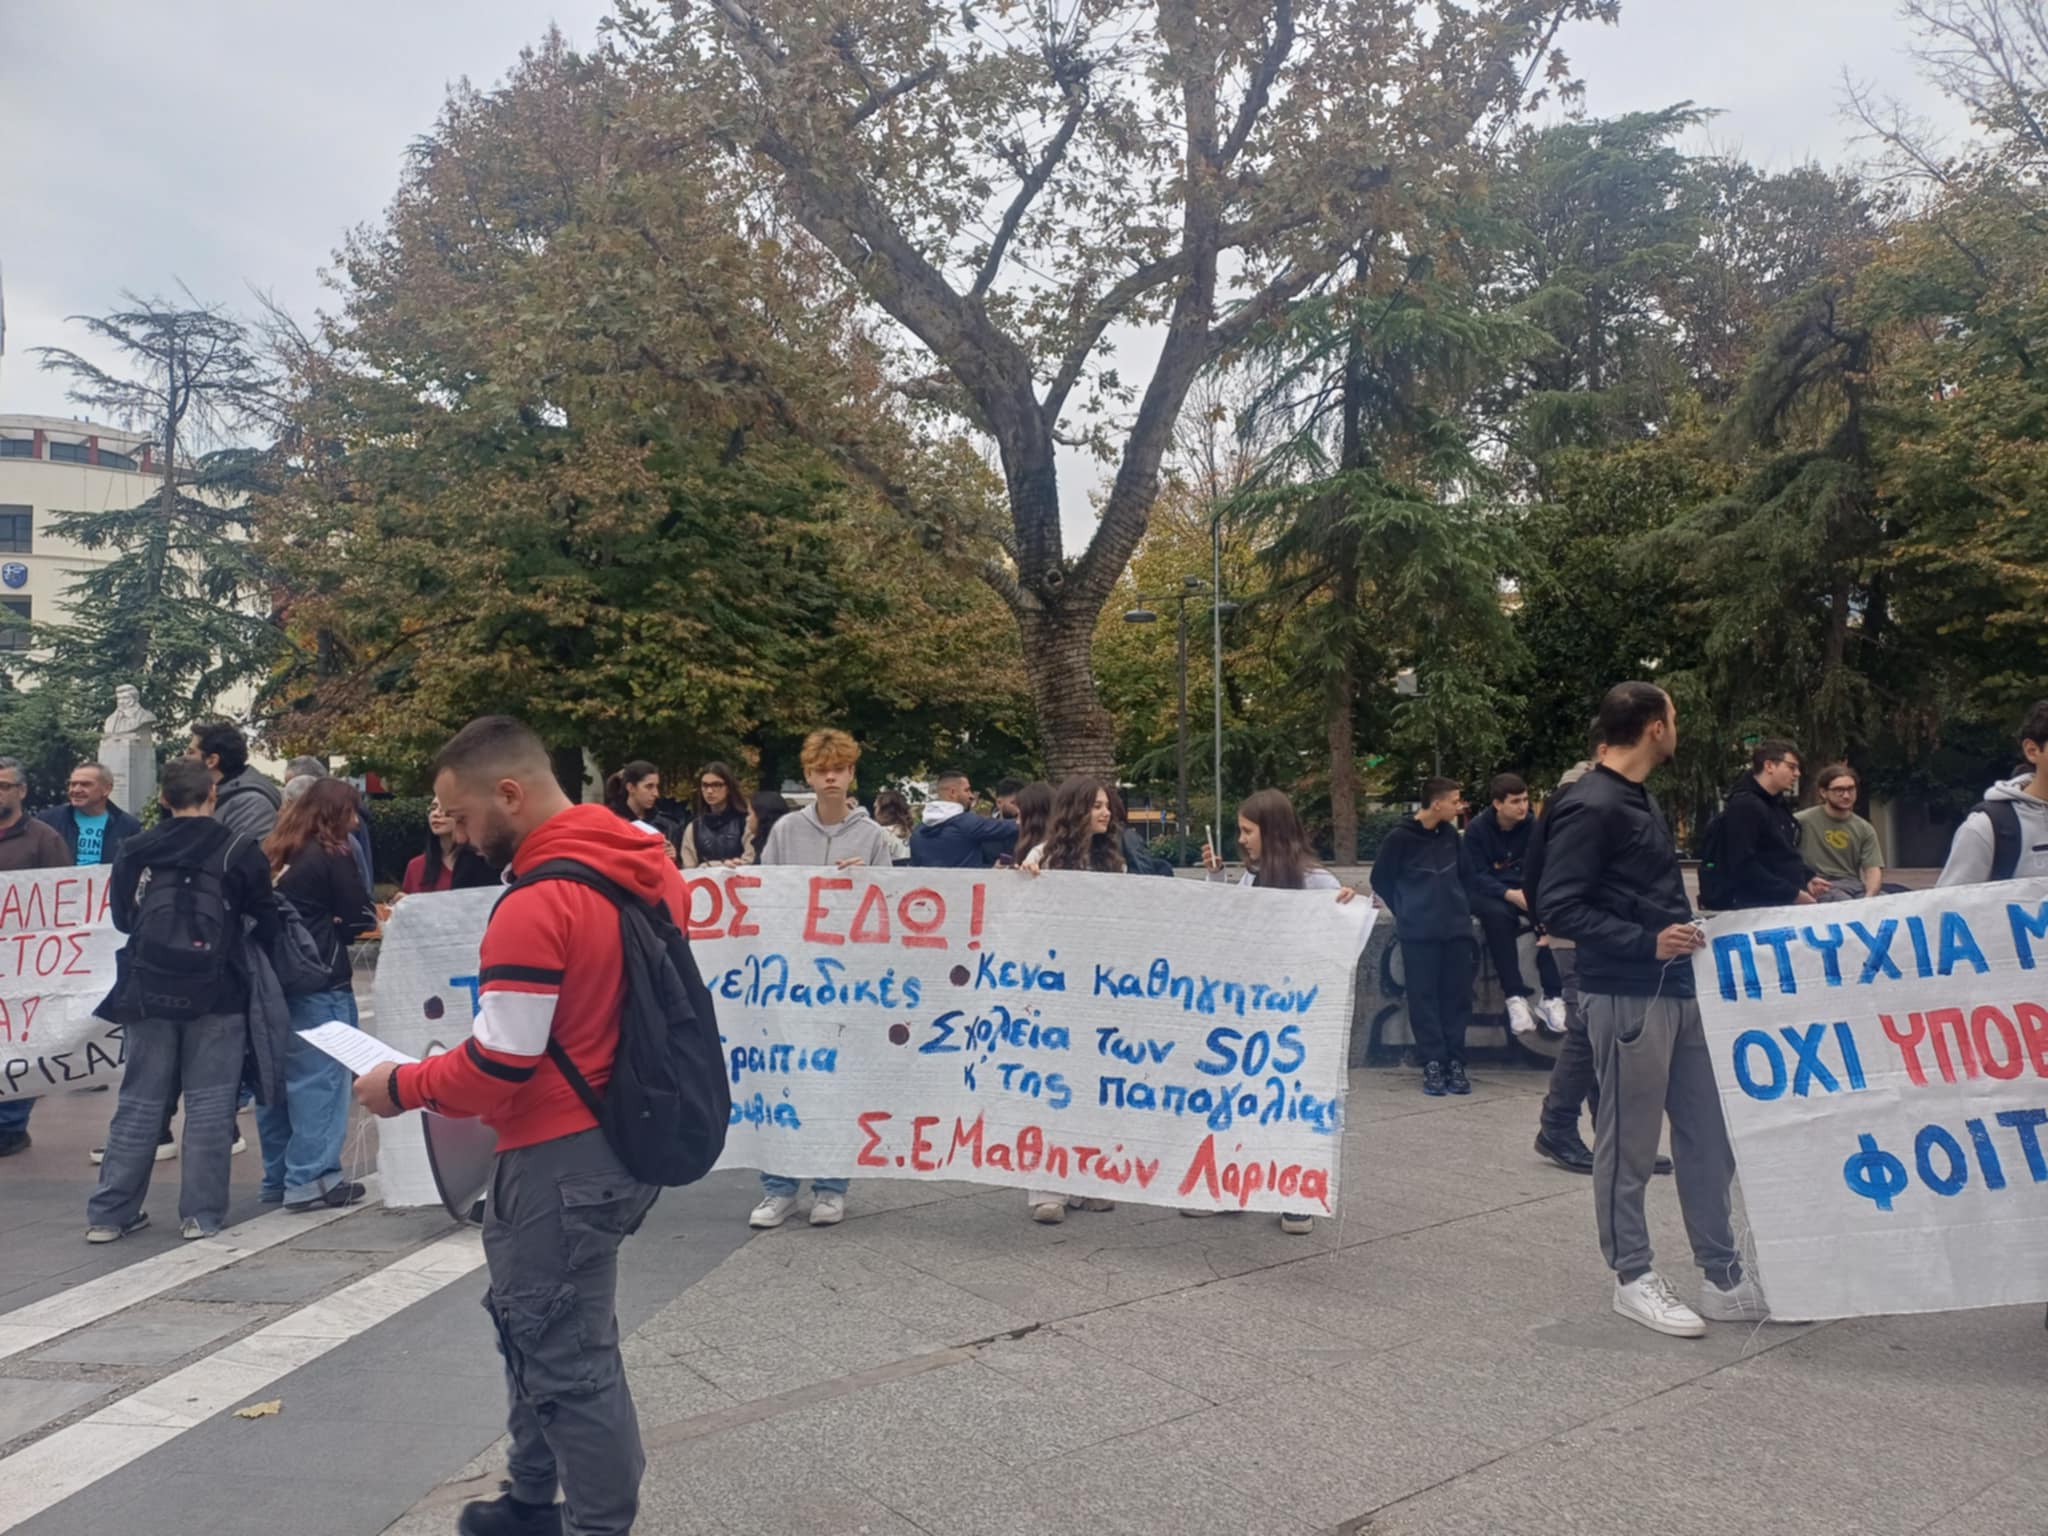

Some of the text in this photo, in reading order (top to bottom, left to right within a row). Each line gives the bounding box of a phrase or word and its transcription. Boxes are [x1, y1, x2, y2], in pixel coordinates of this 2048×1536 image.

[0, 932, 92, 979] ΤΟΣ
[707, 954, 923, 1008] ελλαδικές
[975, 949, 1066, 991] Κενά
[1711, 910, 1990, 1002] ΠΤΥΧΙΑ
[918, 1005, 1307, 1076] Σχολεία των SOS
[1732, 1021, 1867, 1101] ΟΧΙ
[997, 1063, 1073, 1110] της
[1177, 1134, 1332, 1213] Λάρισα
[1843, 1108, 2048, 1211] ΦΟΙΤ
